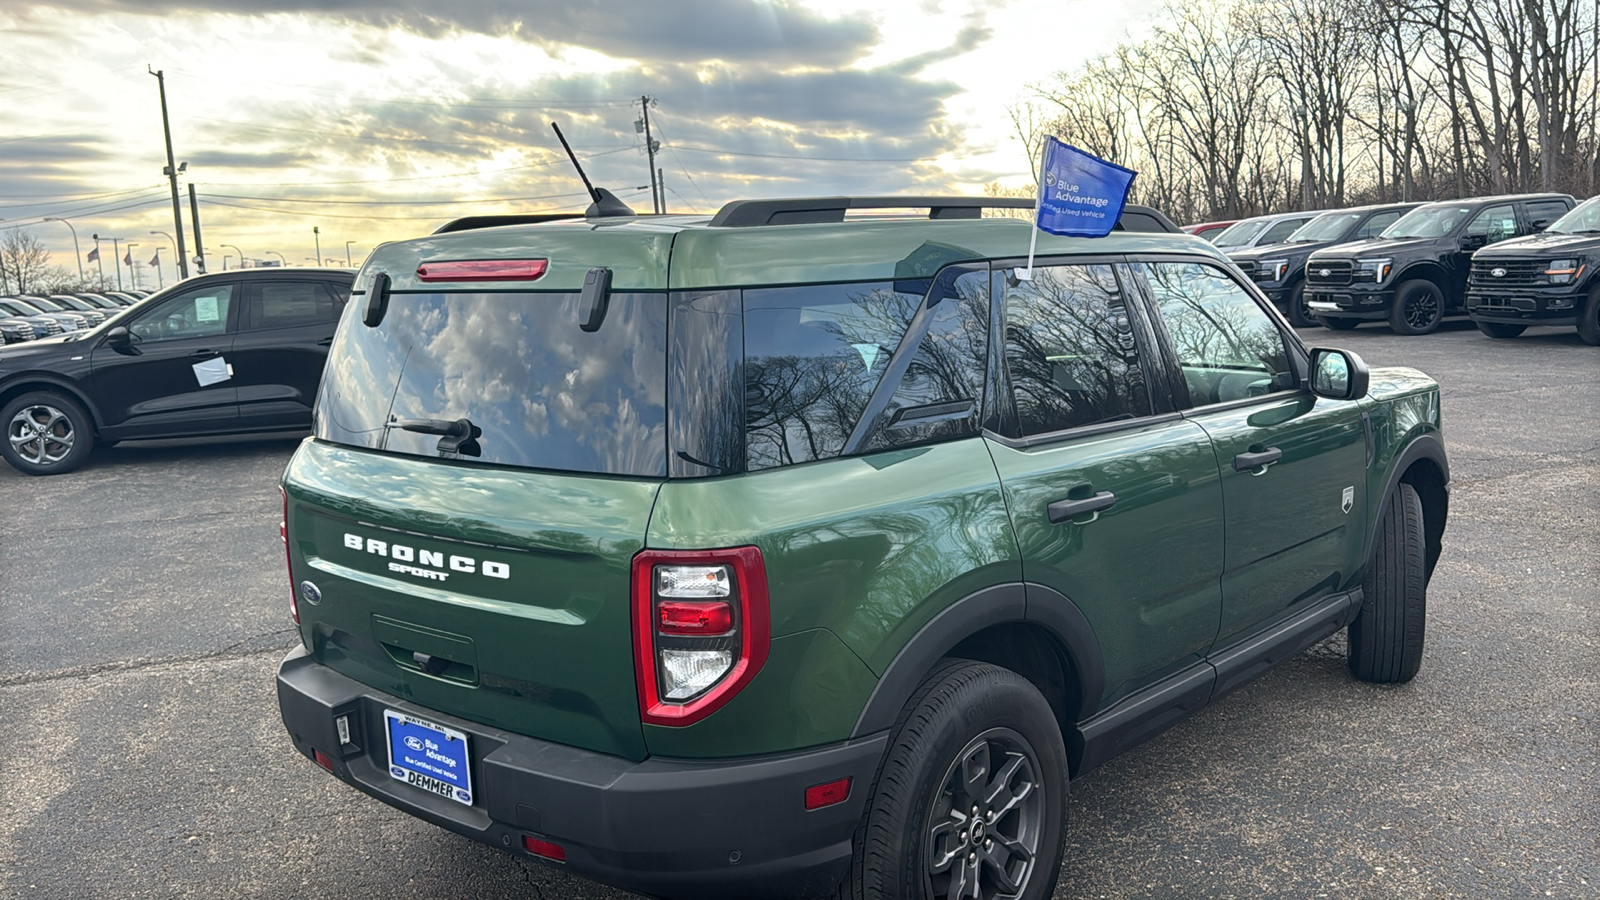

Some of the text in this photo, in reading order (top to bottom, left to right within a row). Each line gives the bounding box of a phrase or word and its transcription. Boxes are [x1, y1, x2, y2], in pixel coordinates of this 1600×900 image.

[1057, 180, 1079, 193] Blue
[1055, 191, 1108, 208] Advantage
[1042, 202, 1105, 219] ertified Used Vehicle
[343, 533, 510, 579] BRONCO
[388, 562, 449, 581] SPORT
[424, 738, 439, 751] Blue
[425, 749, 457, 767] Advantage
[404, 755, 458, 781] Blue Certified Used Vehicle
[408, 771, 453, 798] DEMMER
